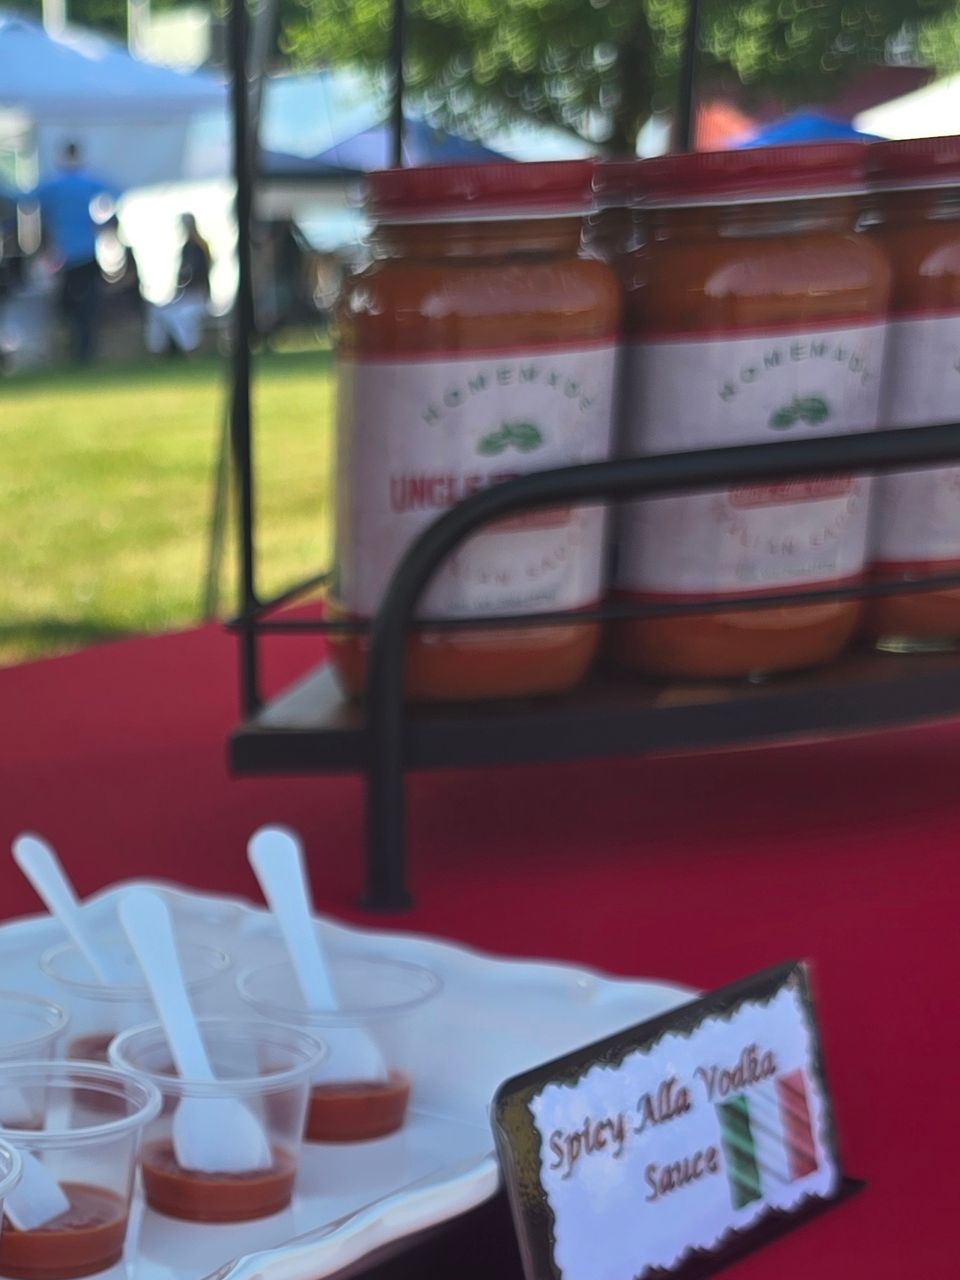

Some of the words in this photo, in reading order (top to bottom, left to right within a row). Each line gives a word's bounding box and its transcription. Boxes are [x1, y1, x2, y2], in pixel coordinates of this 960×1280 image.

[548, 1113, 625, 1181] Spicy
[634, 1074, 692, 1135] Alla
[693, 1043, 777, 1104] Vodka
[644, 1145, 720, 1204] Sauce
